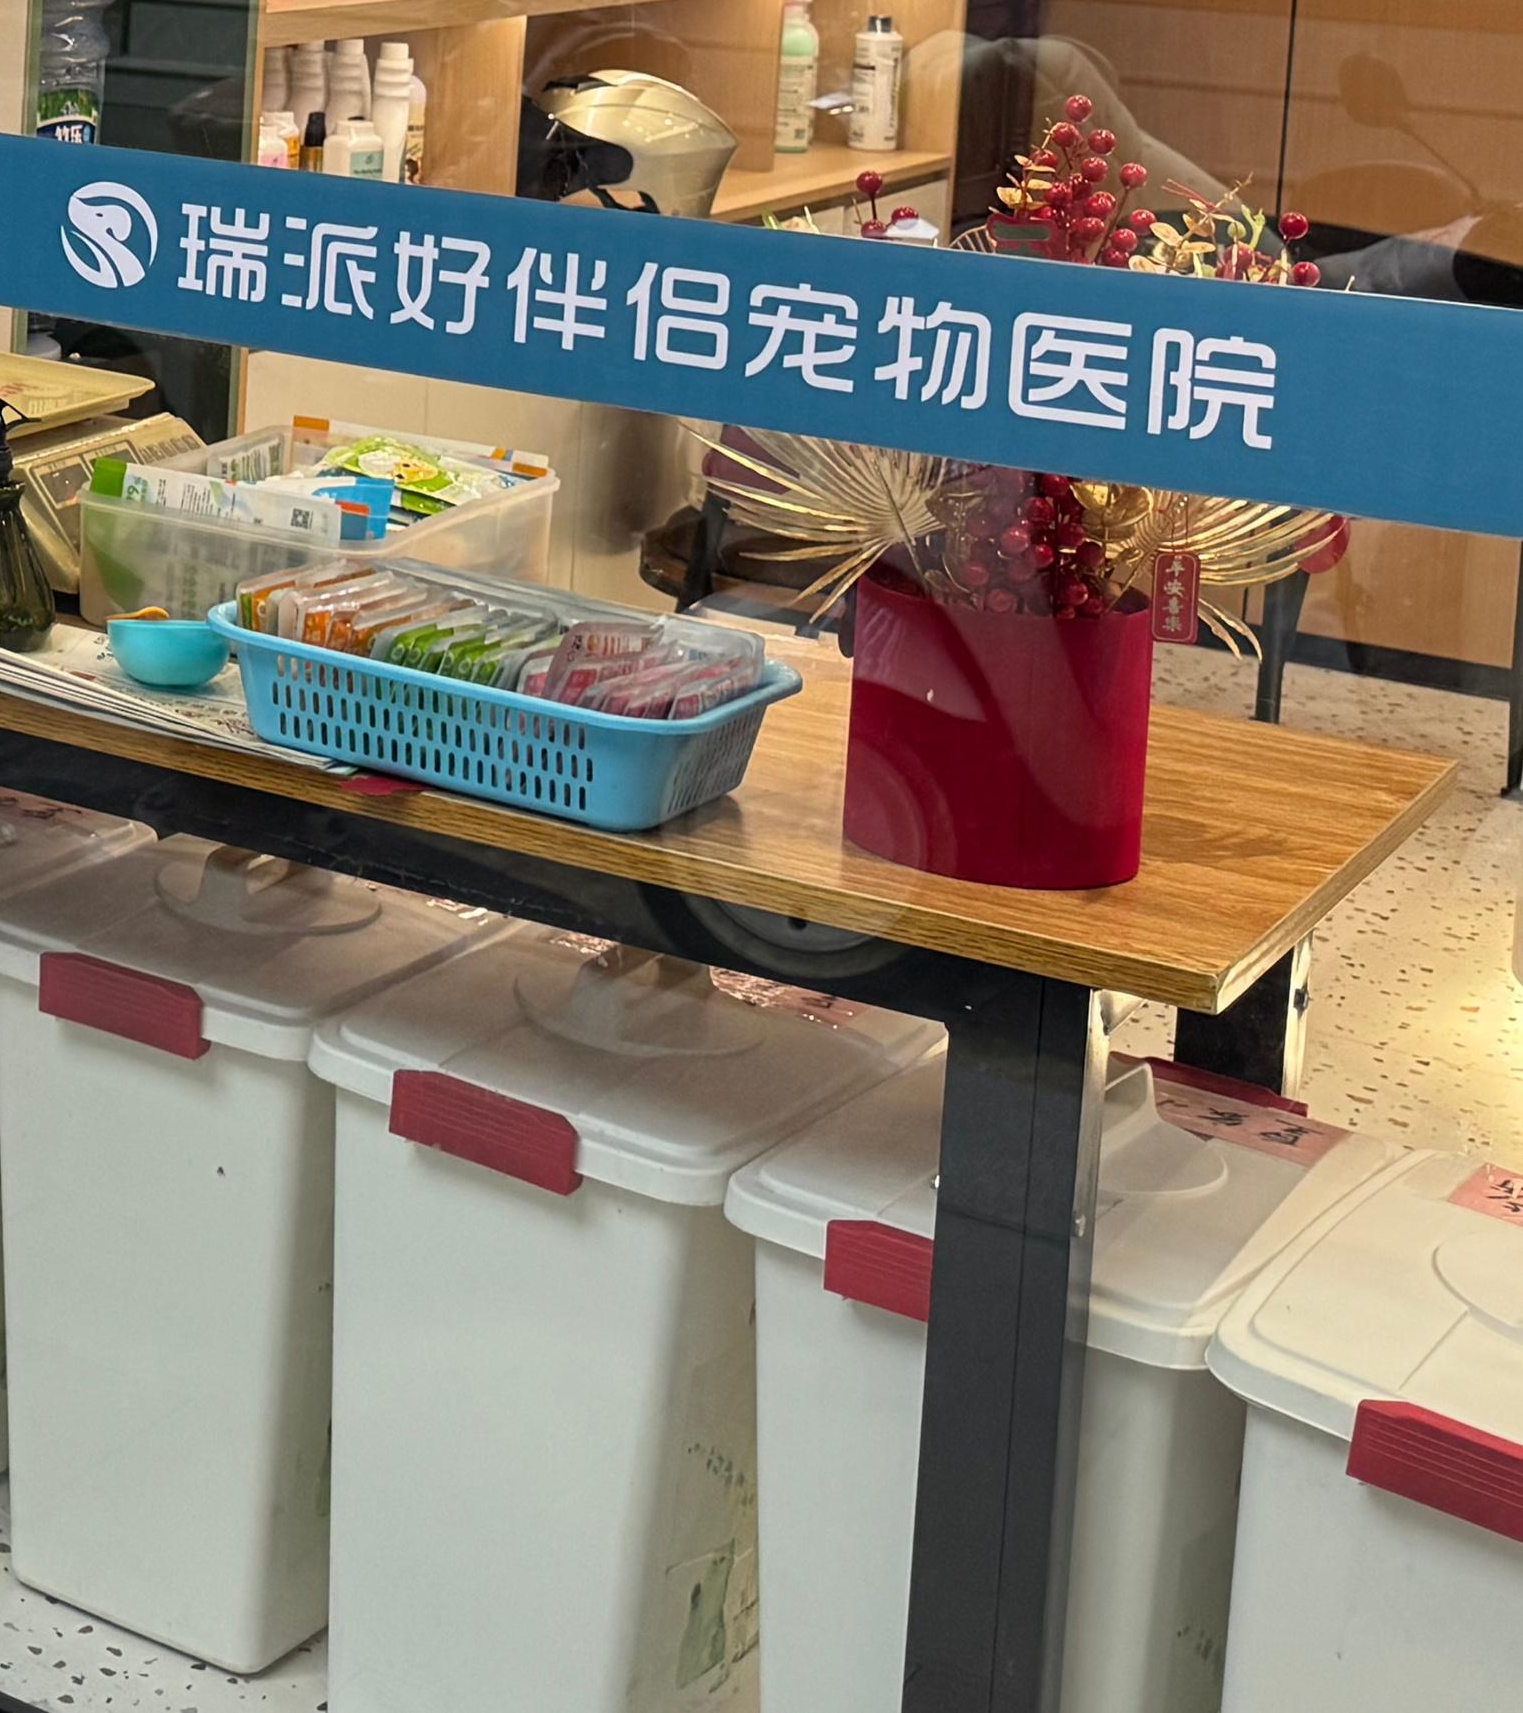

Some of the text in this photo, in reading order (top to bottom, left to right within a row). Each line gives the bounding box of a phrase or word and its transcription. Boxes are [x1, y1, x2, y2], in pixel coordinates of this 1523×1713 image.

[176, 201, 1278, 451] 瑞派好伴侣宠物医院
